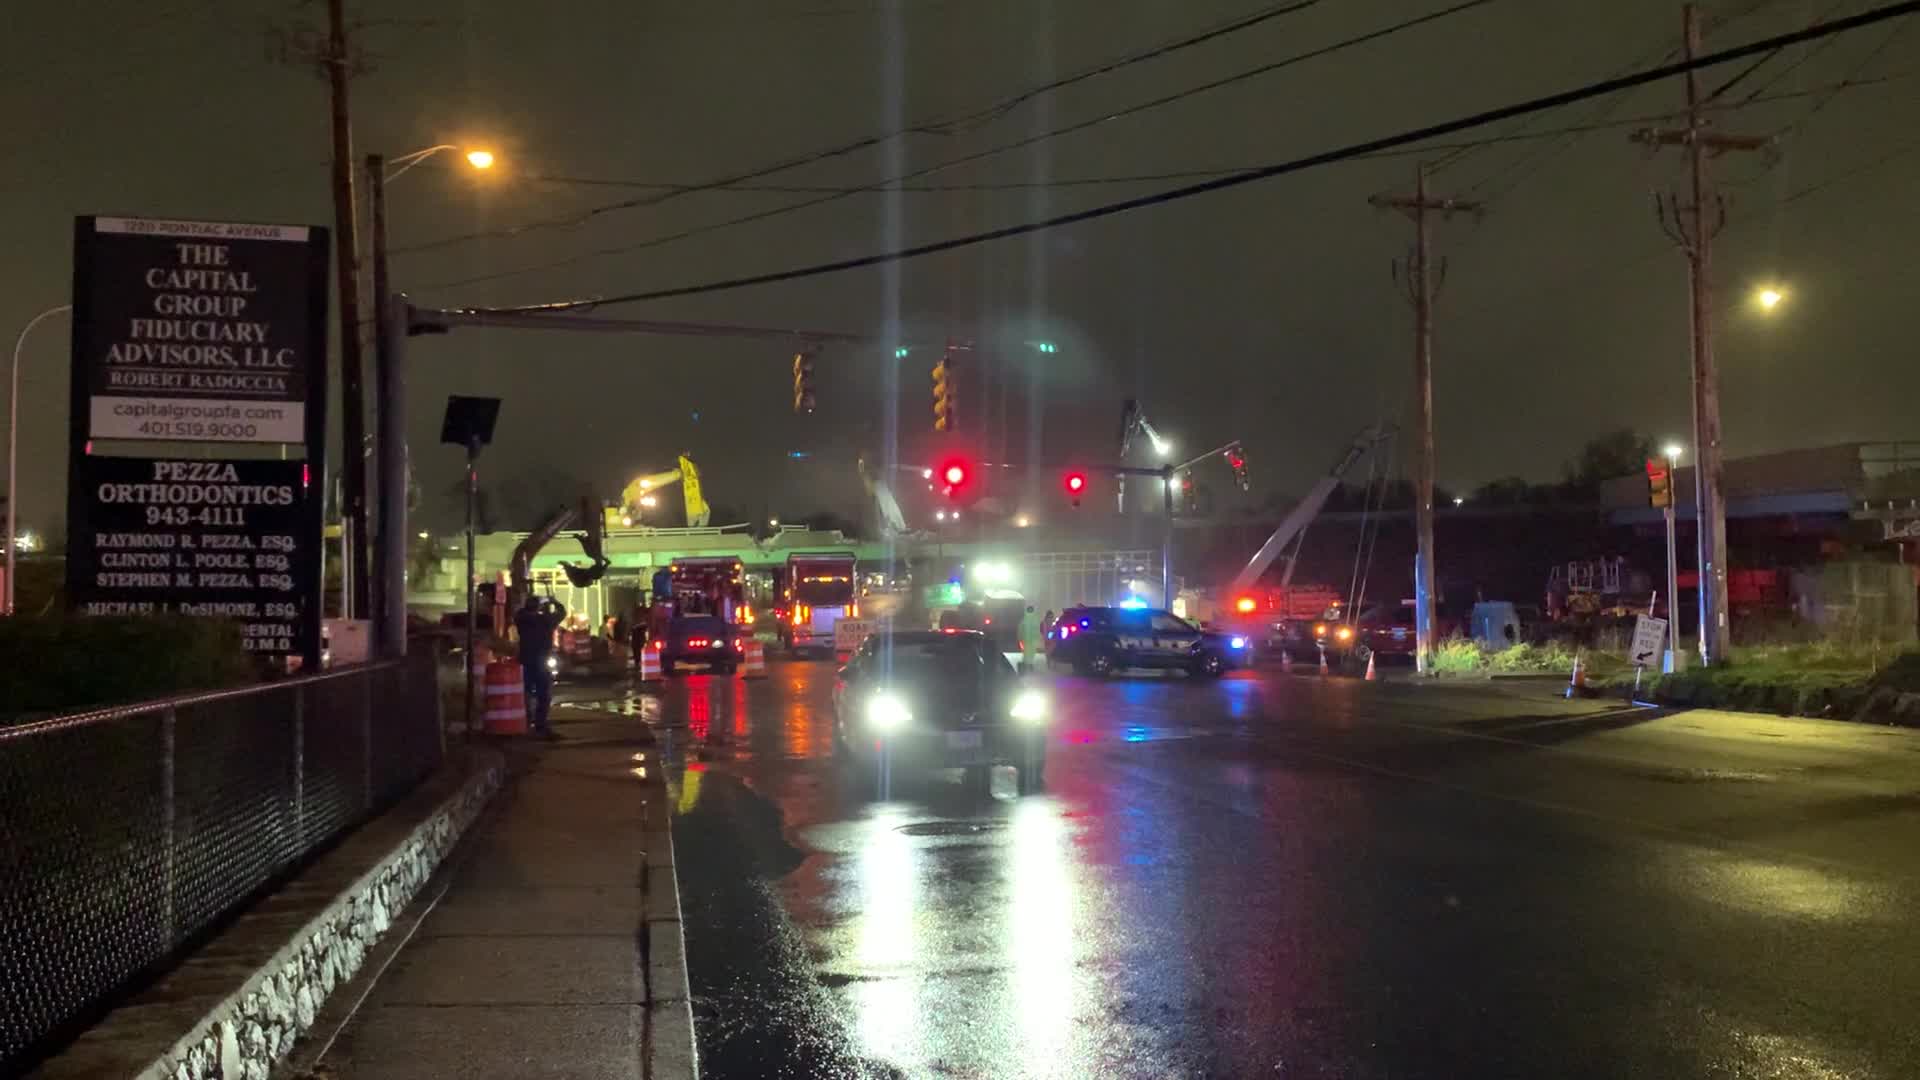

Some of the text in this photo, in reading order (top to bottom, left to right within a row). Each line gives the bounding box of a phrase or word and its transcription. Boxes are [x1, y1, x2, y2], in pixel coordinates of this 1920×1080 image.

[159, 223, 220, 234] PONTIAC
[226, 226, 281, 238] AVENUE
[176, 243, 229, 265] THE
[146, 268, 256, 292] CAPITAL
[154, 294, 246, 316] GROUP
[131, 318, 269, 342] FIDUCIARY
[105, 343, 295, 368] ADVISORS, LLC
[110, 372, 286, 390] ROBERT RADOCCIA
[153, 462, 239, 482] PEZZA
[98, 484, 293, 505] ORTHODONTICS
[146, 506, 246, 526] 943-4111
[95, 533, 175, 548] RAYMOND
[261, 536, 297, 552] ESQ.
[101, 553, 170, 568] CLINTON
[96, 573, 170, 588] STEPHEN
